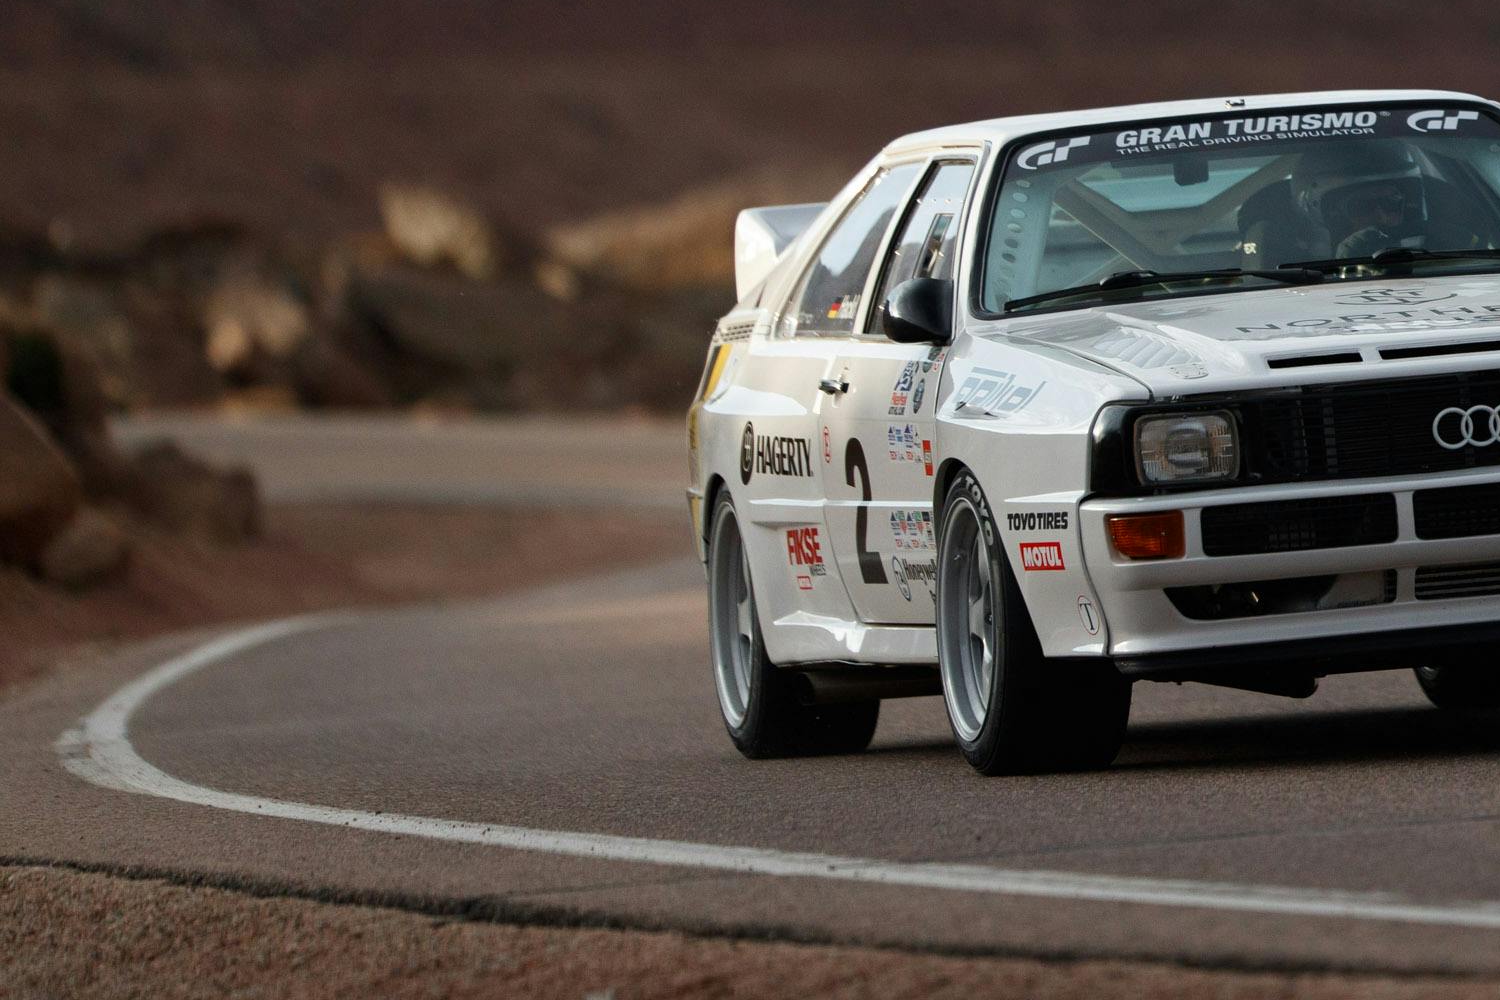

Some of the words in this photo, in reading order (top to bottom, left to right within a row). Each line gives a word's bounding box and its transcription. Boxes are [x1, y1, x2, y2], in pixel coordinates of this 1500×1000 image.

[1116, 122, 1212, 148] GRAN
[1224, 111, 1377, 136] TURISMO
[1117, 144, 1150, 156] THE
[1155, 140, 1199, 151] REAL
[1203, 133, 1272, 146] DRIVING
[1276, 127, 1375, 140] SIMULATOR
[845, 437, 889, 584] 2
[965, 475, 994, 546] TOYO
[1007, 512, 1036, 531] TOYO
[1037, 511, 1068, 530] TIRES
[786, 527, 823, 566] FIKSE
[1023, 546, 1062, 567] MOTUL
